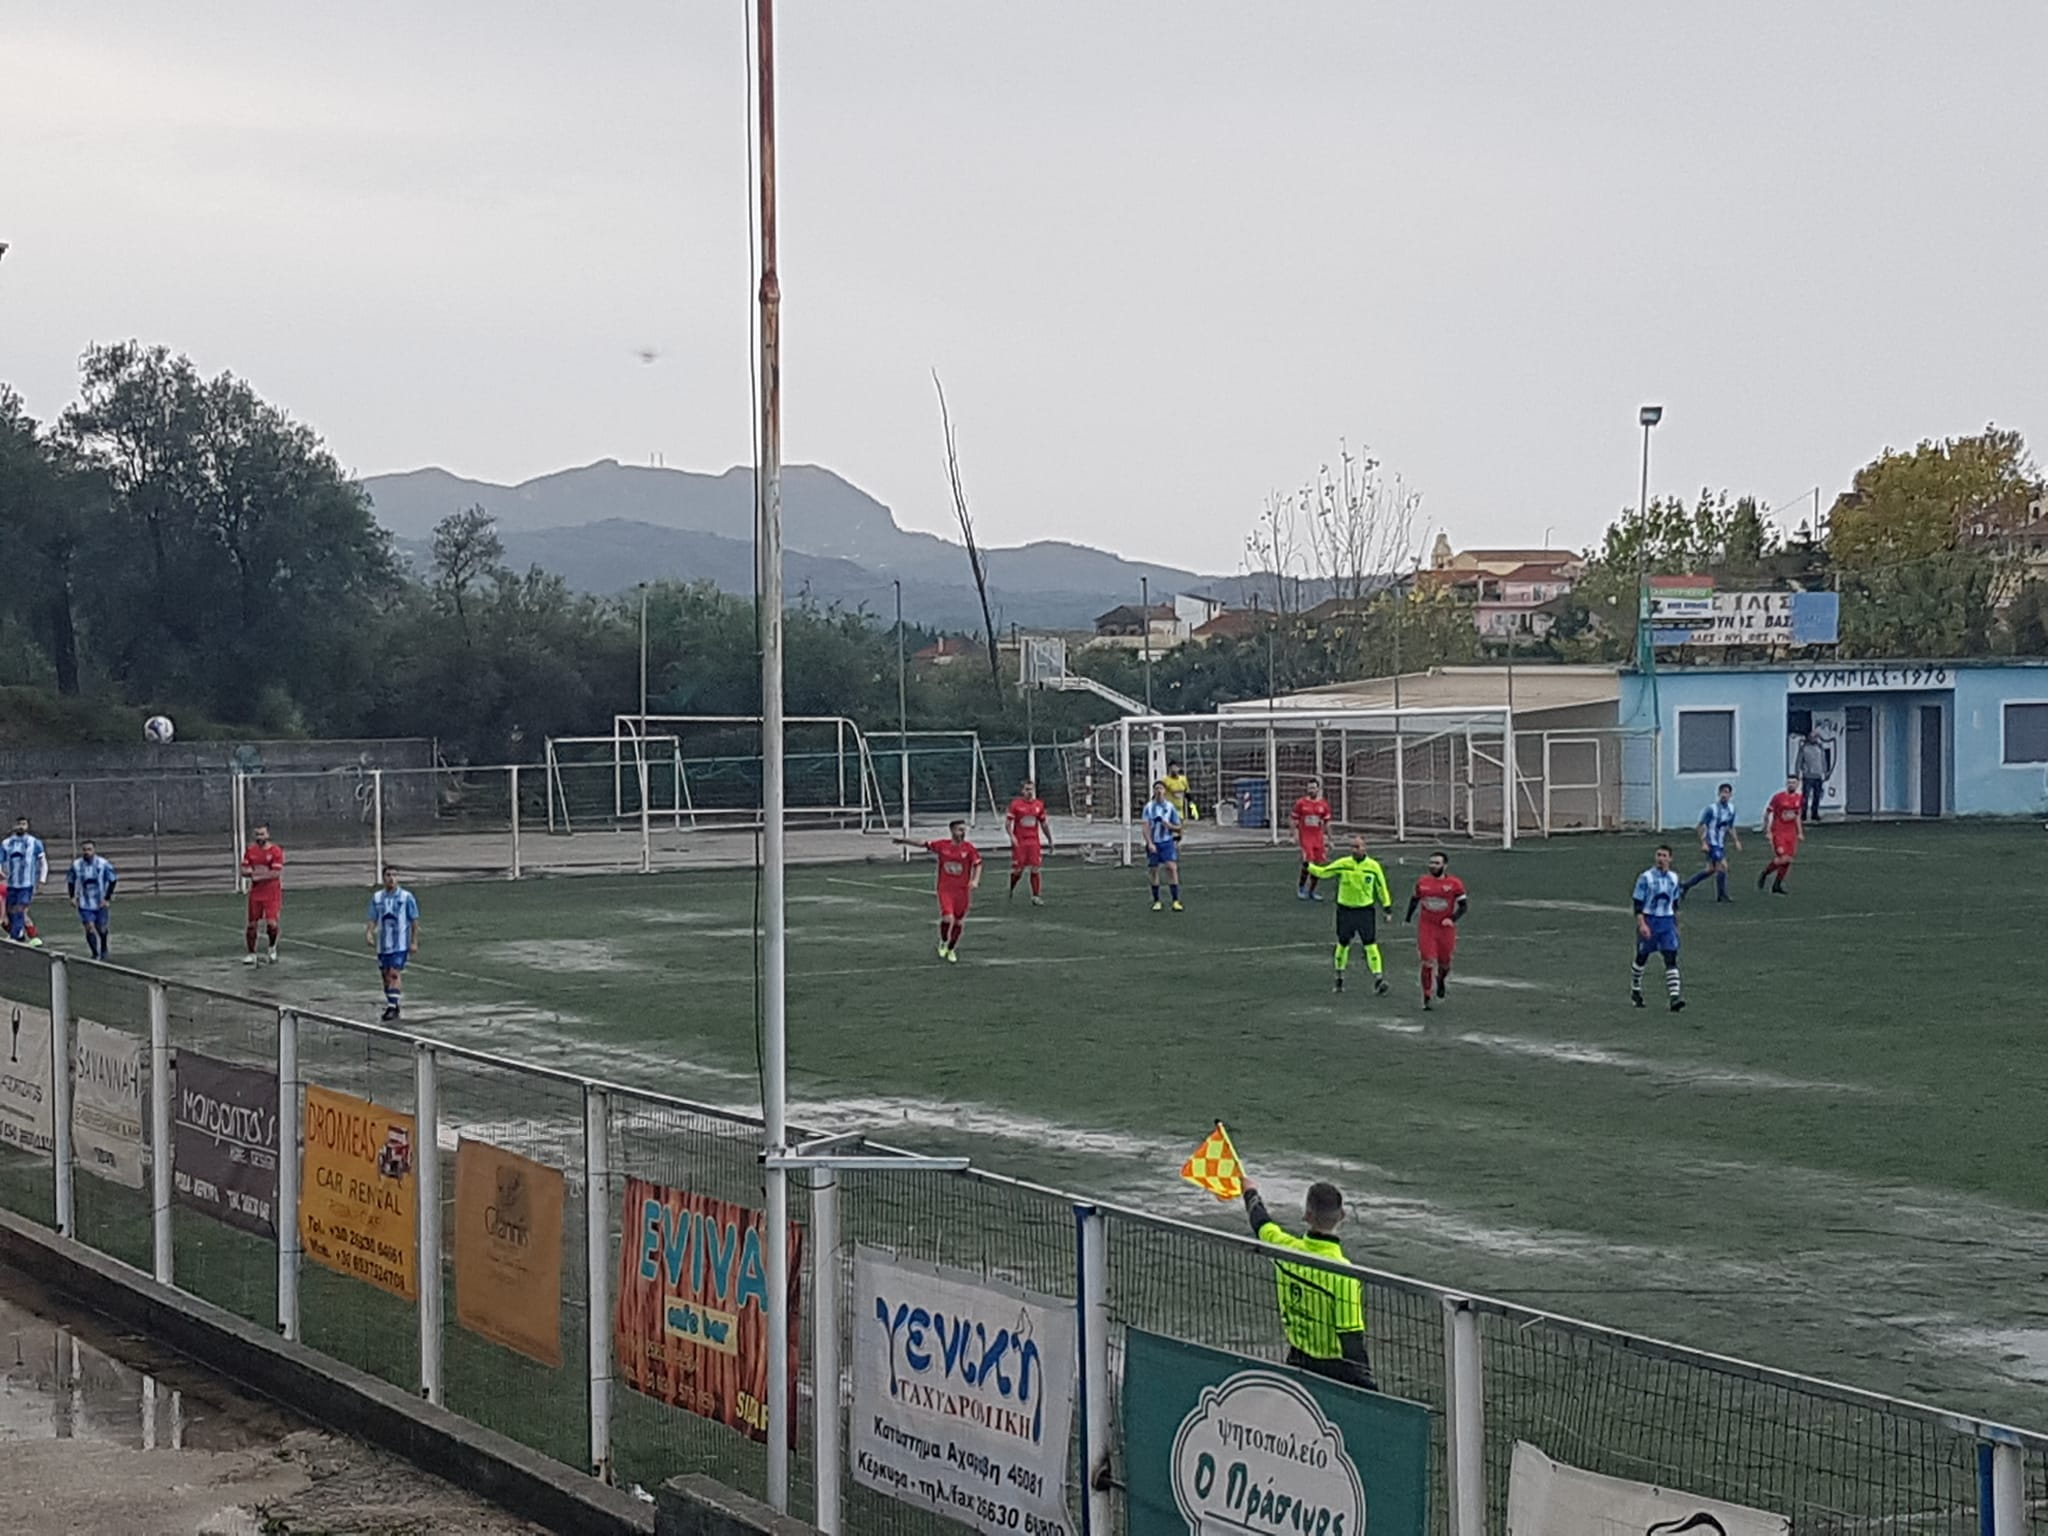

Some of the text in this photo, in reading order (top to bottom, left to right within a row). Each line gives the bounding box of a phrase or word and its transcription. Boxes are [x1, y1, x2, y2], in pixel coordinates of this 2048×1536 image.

[1794, 667, 1945, 688] ΟΛΥΜΠΙΑΣ 1970
[308, 1102, 377, 1163] DROMEAS
[316, 1166, 343, 1193] CAR
[350, 1178, 403, 1216] RENTAL
[640, 1199, 768, 1313] EVIVA
[898, 1378, 1031, 1440] ΤΑΧΥΔΡΟΜΙΚΗ
[1217, 1418, 1328, 1469] ψητοπωλείο
